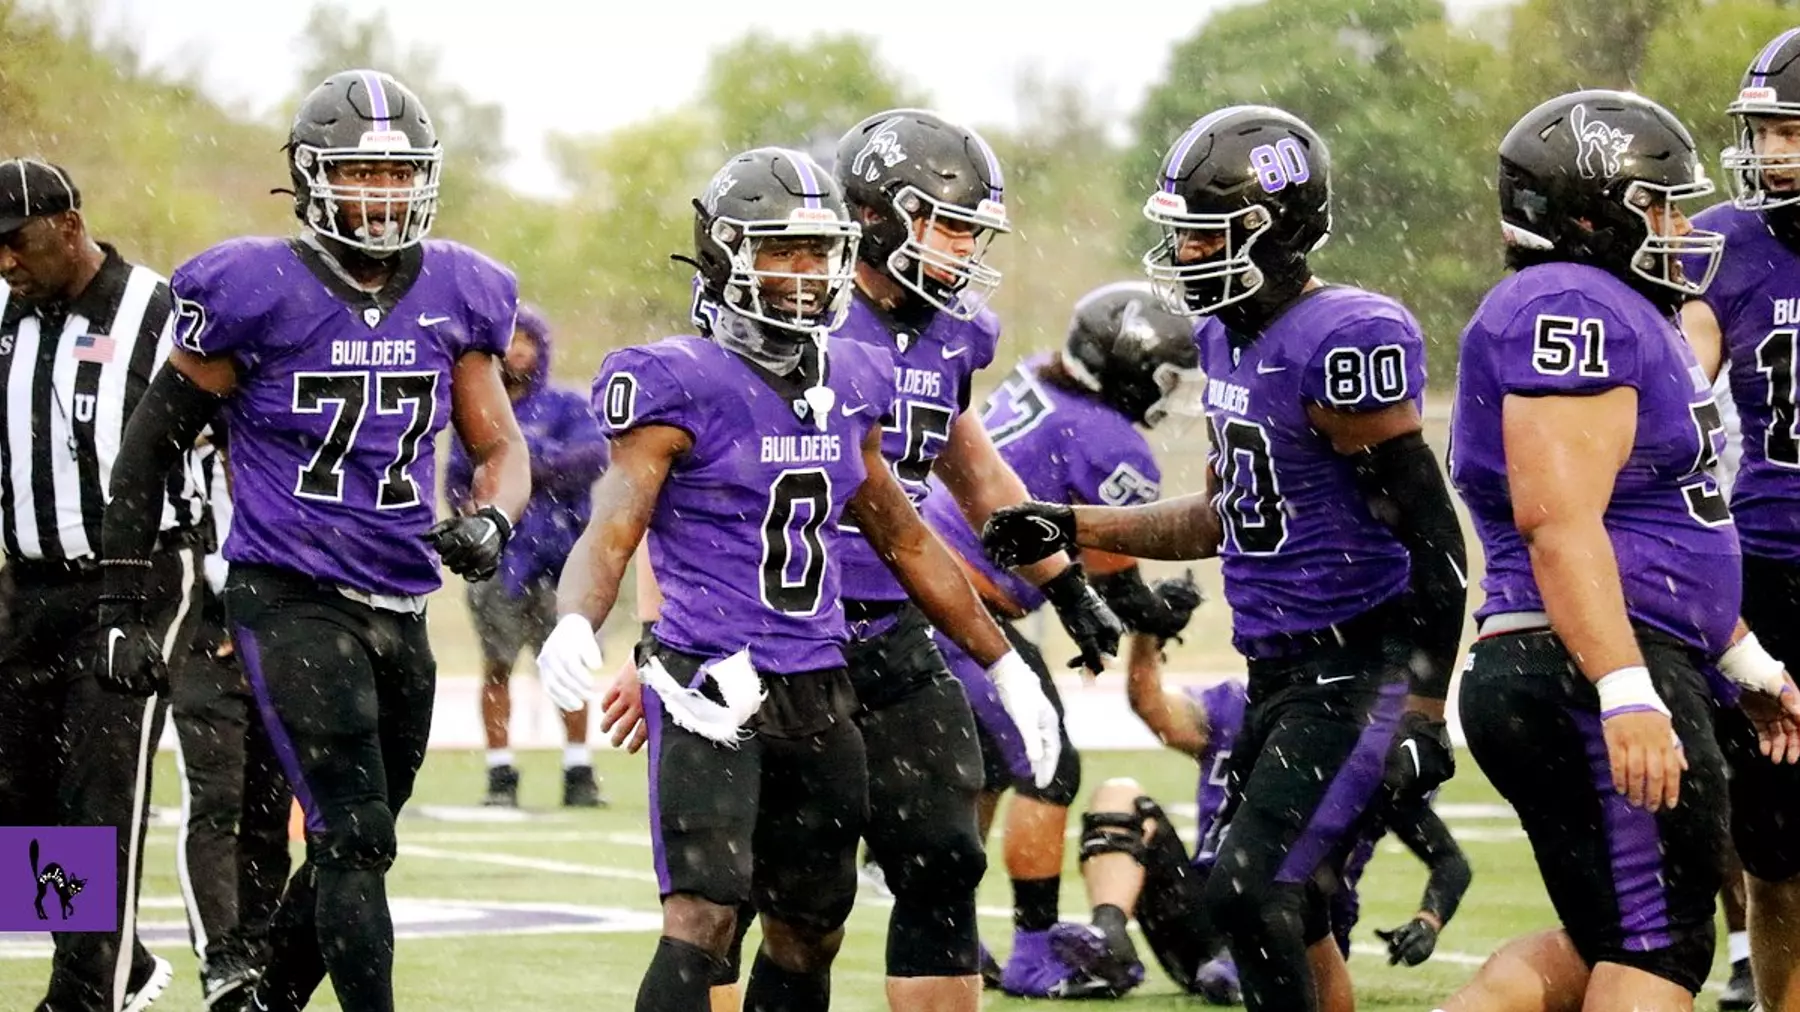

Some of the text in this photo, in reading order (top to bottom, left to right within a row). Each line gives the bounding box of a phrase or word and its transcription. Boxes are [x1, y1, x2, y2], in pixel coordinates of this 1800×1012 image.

[1249, 137, 1310, 194] 80
[0, 335, 14, 355] S
[331, 340, 416, 366] BUILDERS
[1532, 314, 1609, 377] 51
[604, 372, 637, 429] 0
[1325, 344, 1407, 404] 80
[75, 394, 95, 422] U
[292, 371, 439, 510] 77
[761, 435, 840, 462] BUILDERS
[759, 467, 832, 616] 0
